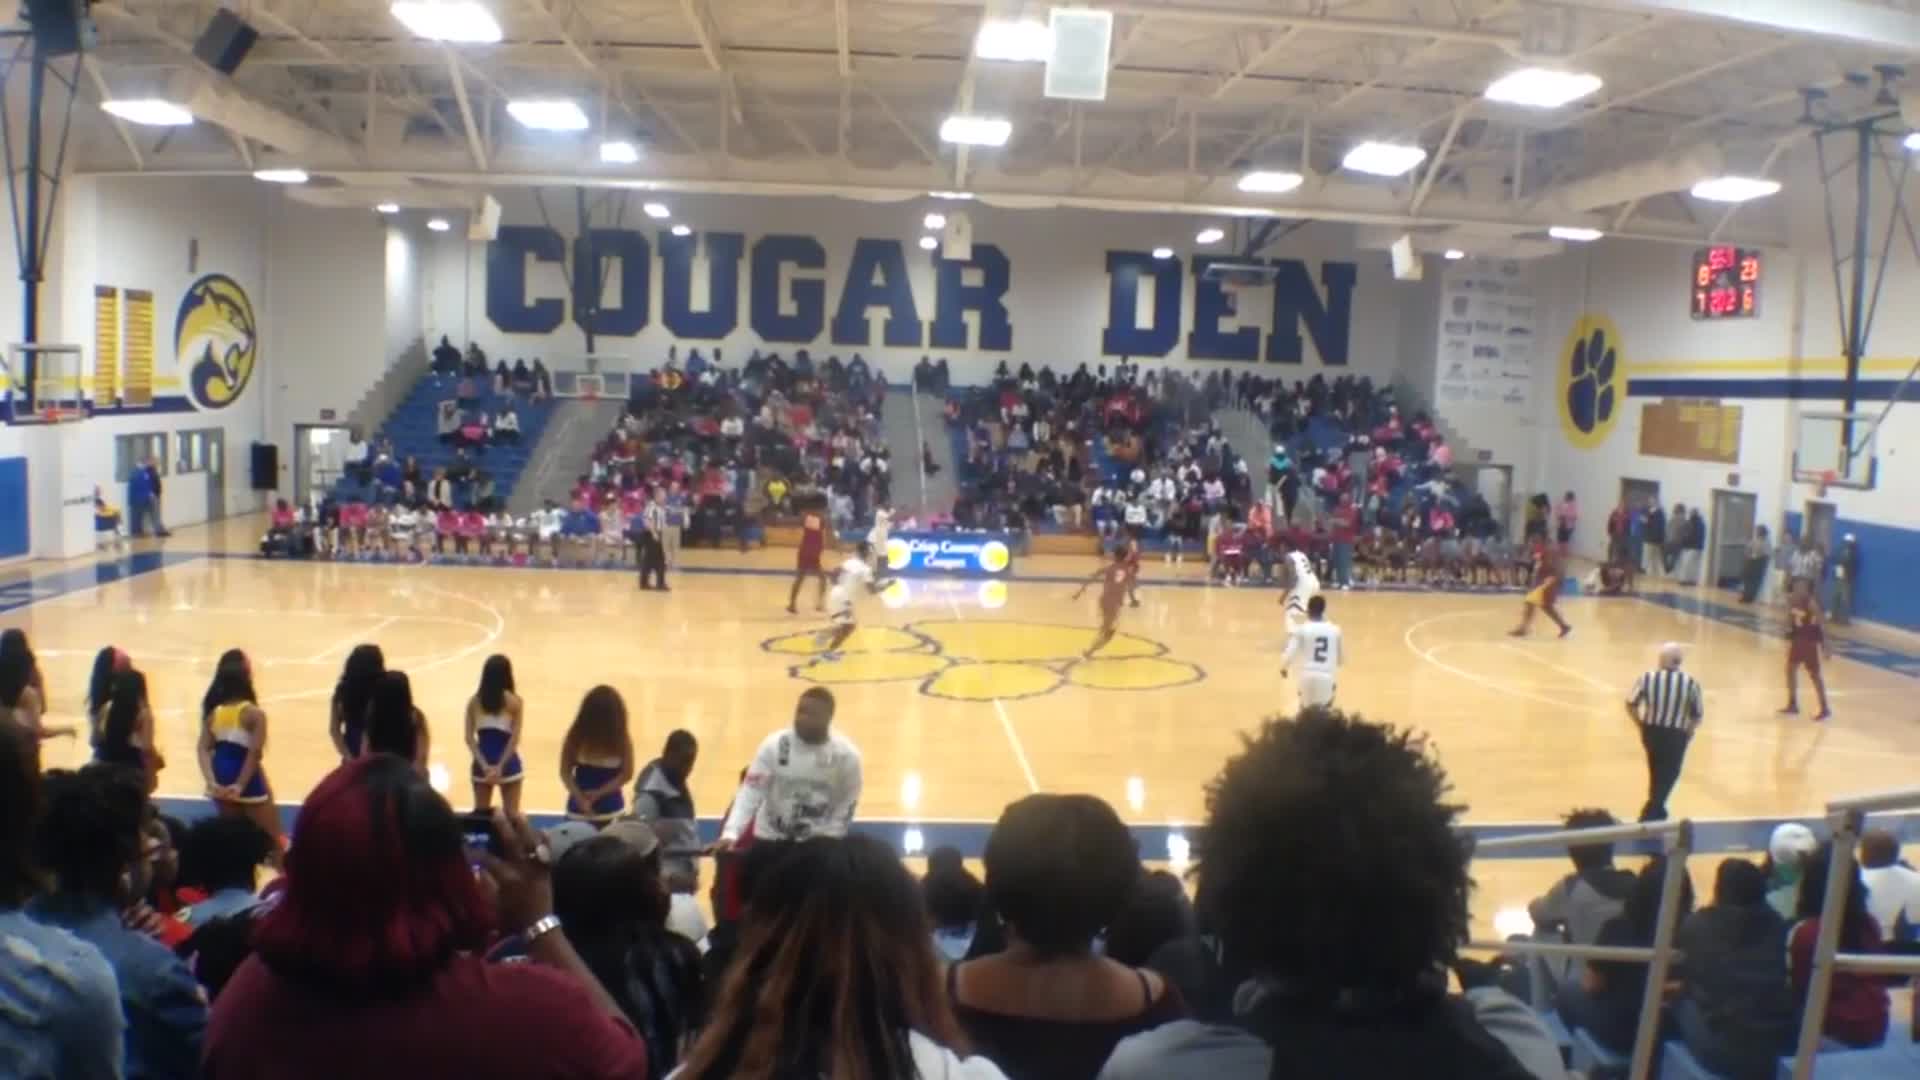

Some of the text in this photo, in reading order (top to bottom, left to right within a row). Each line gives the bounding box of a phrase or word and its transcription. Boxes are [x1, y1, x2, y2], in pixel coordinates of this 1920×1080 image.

[486, 226, 1357, 366] COUGAR DEN
[1313, 636, 1330, 664] 2
